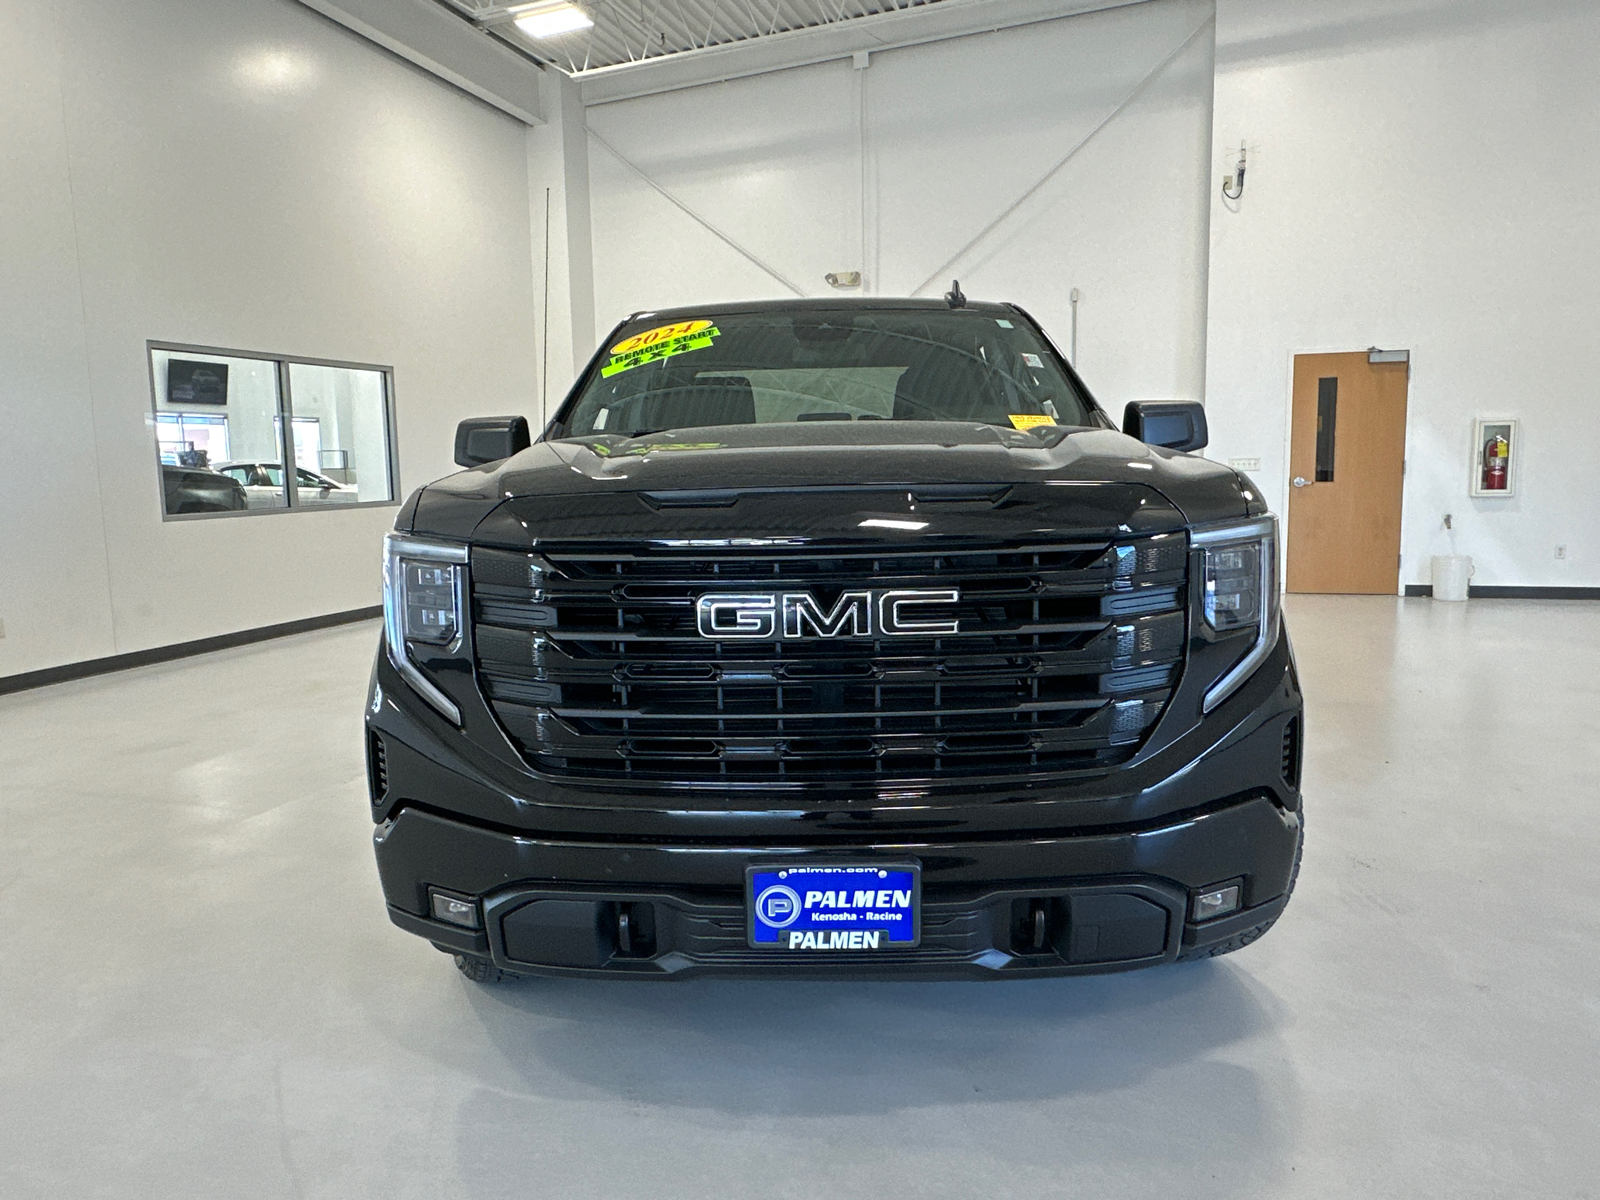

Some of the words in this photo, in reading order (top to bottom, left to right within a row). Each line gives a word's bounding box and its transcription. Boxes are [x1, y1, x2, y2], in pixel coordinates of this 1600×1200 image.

[626, 322, 695, 351] 2024
[615, 340, 671, 364] REMOTE
[673, 330, 716, 345] START
[696, 589, 959, 638] GMC
[788, 867, 878, 875] palmen.com
[804, 890, 911, 908] PALMEN
[811, 912, 857, 921] Kenosha
[866, 912, 903, 921] Racine
[788, 931, 880, 949] PALMEN
